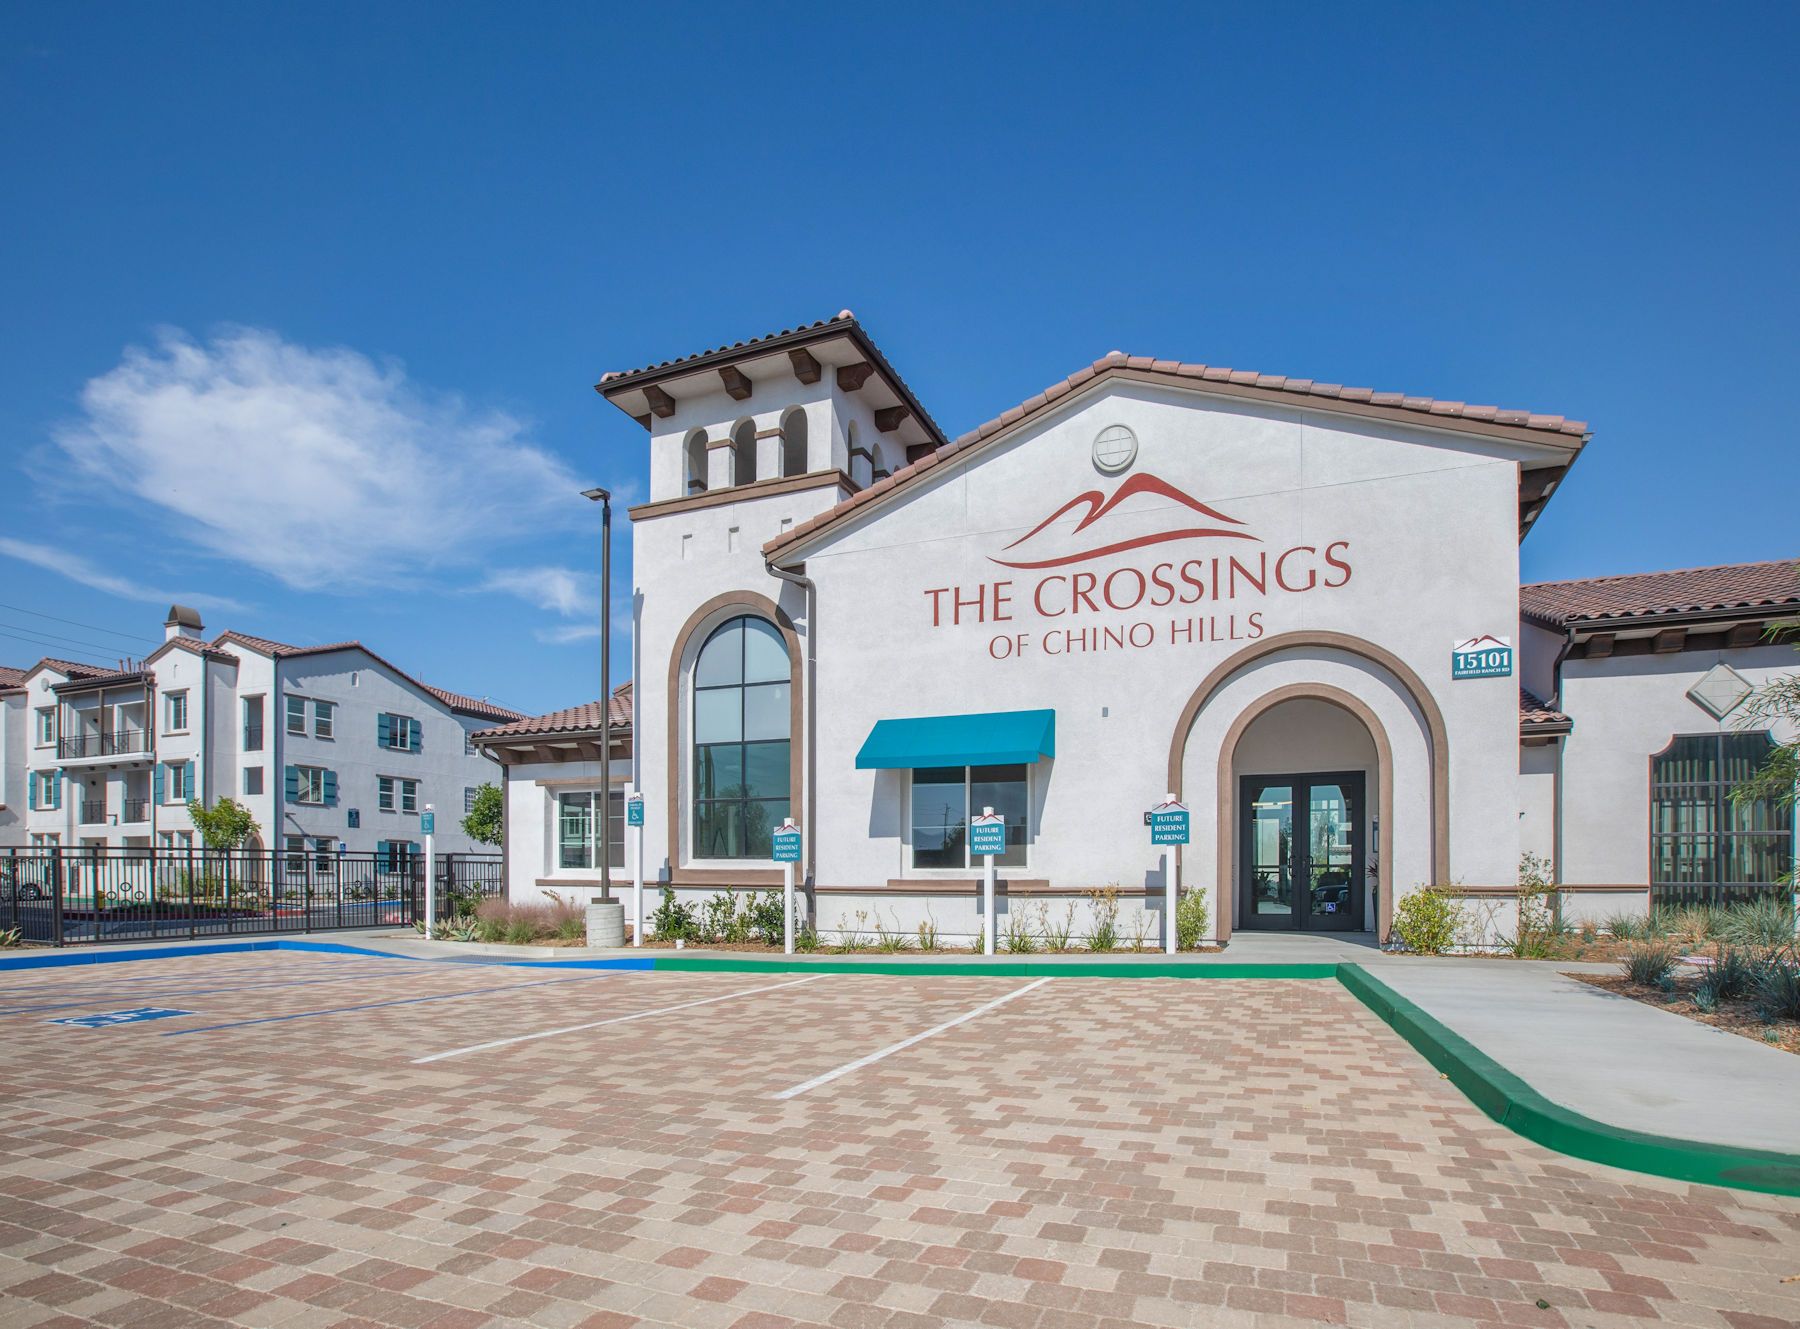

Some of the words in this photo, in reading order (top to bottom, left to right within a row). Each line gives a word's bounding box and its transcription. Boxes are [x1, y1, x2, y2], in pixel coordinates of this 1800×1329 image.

[924, 580, 1013, 627] THE
[1034, 541, 1352, 616] CROSSINGS
[989, 633, 1030, 660] OF
[1042, 622, 1154, 655] CHINO
[1171, 611, 1265, 645] HILLS
[1457, 651, 1509, 669] 15101
